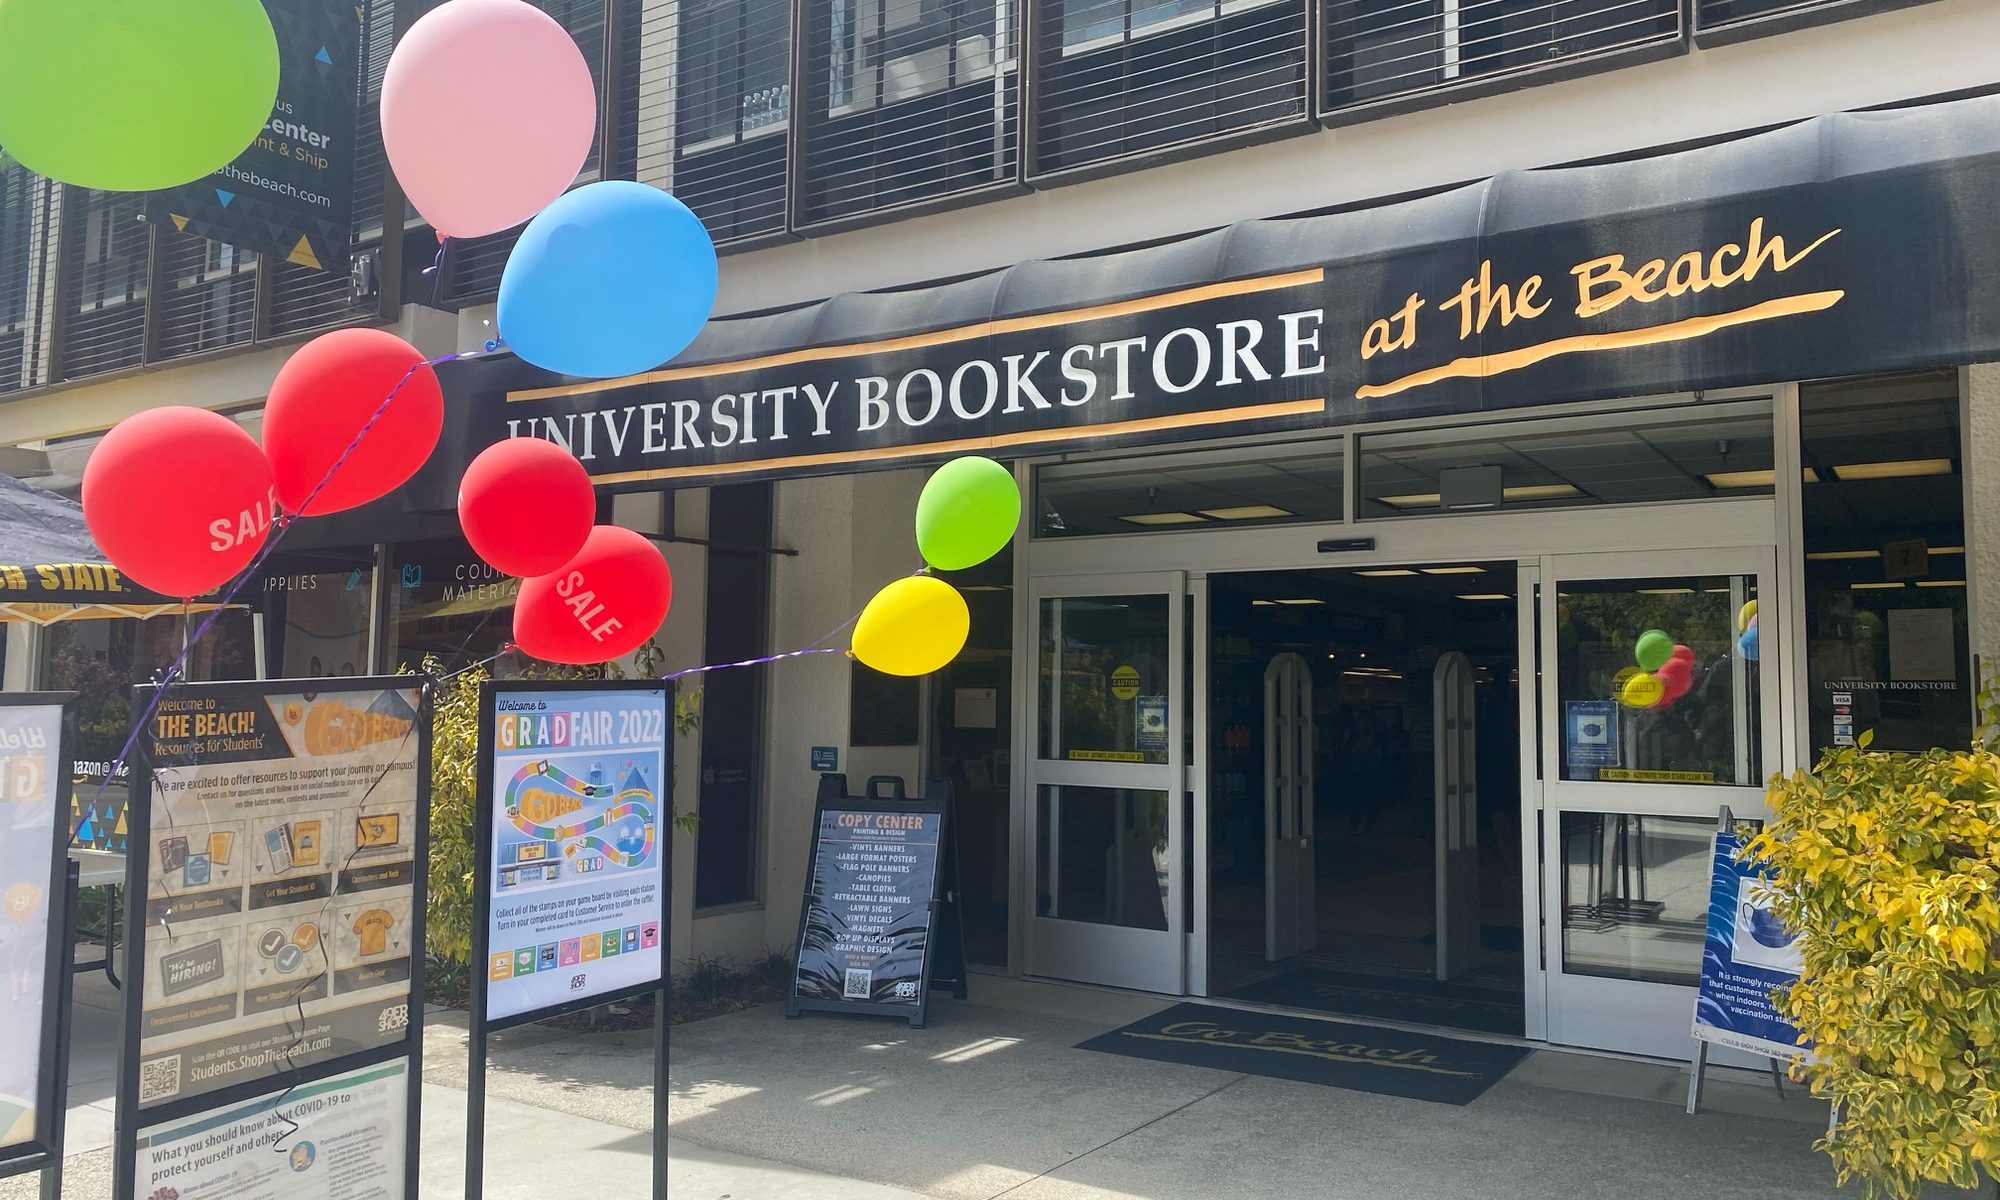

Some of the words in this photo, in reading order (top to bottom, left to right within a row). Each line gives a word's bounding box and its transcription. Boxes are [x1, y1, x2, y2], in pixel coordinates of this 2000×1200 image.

[279, 142, 290, 157] &
[295, 147, 328, 170] Ship
[1360, 292, 1425, 360] at
[1439, 259, 1552, 340] the
[1569, 217, 1842, 318] Beach
[855, 308, 1326, 432] BOOKSTORE
[39, 562, 122, 592] STATE
[556, 570, 623, 643] SALE
[1112, 679, 1139, 687] CAUTION
[1824, 681, 1887, 690] UNIVERSITY
[1890, 681, 1957, 690] BOOKSTORE
[206, 698, 216, 710] to
[498, 700, 537, 712] Welcome
[537, 699, 547, 711] to
[158, 714, 190, 738] THE
[195, 711, 255, 736] BEACH!
[618, 709, 662, 744] 2022
[207, 738, 220, 752] for
[223, 738, 263, 752] Students
[171, 781, 186, 791] are
[188, 776, 218, 790] excited
[220, 777, 229, 786] to
[231, 774, 251, 786] offer
[252, 771, 288, 784] resources
[290, 770, 299, 780] to
[299, 766, 329, 782] support
[330, 765, 347, 777] your
[347, 762, 374, 777] journey
[375, 761, 386, 772] on
[838, 813, 873, 827] COPY
[876, 815, 924, 830] CENTER
[874, 844, 906, 853] BANNERS
[577, 858, 603, 873] GRAD
[860, 854, 887, 862] FORMAT
[888, 855, 917, 863] POSTERS
[861, 864, 875, 872] POLE
[878, 865, 910, 873] BANNERS
[872, 885, 896, 893] CLOTHS
[496, 908, 514, 919] Collect
[522, 905, 529, 913] of
[529, 904, 538, 913] the
[539, 901, 557, 912] stamps
[565, 898, 577, 907] your
[577, 896, 591, 906] game
[592, 892, 606, 902] board
[606, 892, 612, 900] by
[613, 889, 630, 898] visiting
[630, 886, 640, 895] each
[640, 884, 656, 894] station
[879, 895, 911, 904] BANNERS
[497, 921, 510, 931] Turn
[511, 920, 516, 929] in
[516, 918, 529, 929] your
[530, 911, 557, 925] completed
[558, 910, 569, 920] card
[569, 909, 575, 918] to
[575, 906, 598, 917] Customer
[598, 902, 615, 912] Service
[615, 901, 620, 909] to
[621, 900, 633, 909] enter
[633, 897, 641, 906] the
[871, 905, 892, 913] SIGNS
[868, 916, 893, 924] DECALS
[852, 934, 862, 942] UP
[863, 935, 895, 944] DISPLAYS
[867, 946, 892, 954] DESIGN
[170, 959, 217, 984] HIRING!
[1718, 970, 1724, 978] It
[1724, 971, 1731, 980] is
[1732, 974, 1762, 988] strongly
[1709, 979, 1724, 989] that
[1724, 982, 1763, 997] customers
[1715, 991, 1735, 1002] when
[1736, 994, 1767, 1010] indoors,
[379, 1003, 409, 1020] 49ER
[1730, 1005, 1774, 1021] vaccination
[378, 1017, 409, 1032] SHOPS
[1160, 1021, 1238, 1042] Go
[1248, 1031, 1442, 1066] Beach
[1741, 1042, 1754, 1050] SIGN
[151, 1147, 182, 1164] What
[184, 1141, 203, 1157] you
[205, 1125, 238, 1148] should
[240, 1118, 265, 1139] know
[267, 1109, 293, 1130] about
[294, 1093, 338, 1117] COVID-19
[341, 1093, 350, 1103] to
[151, 1160, 192, 1185] protect
[194, 1146, 234, 1172] yourself
[236, 1139, 253, 1154] and
[255, 1128, 284, 1149] others
